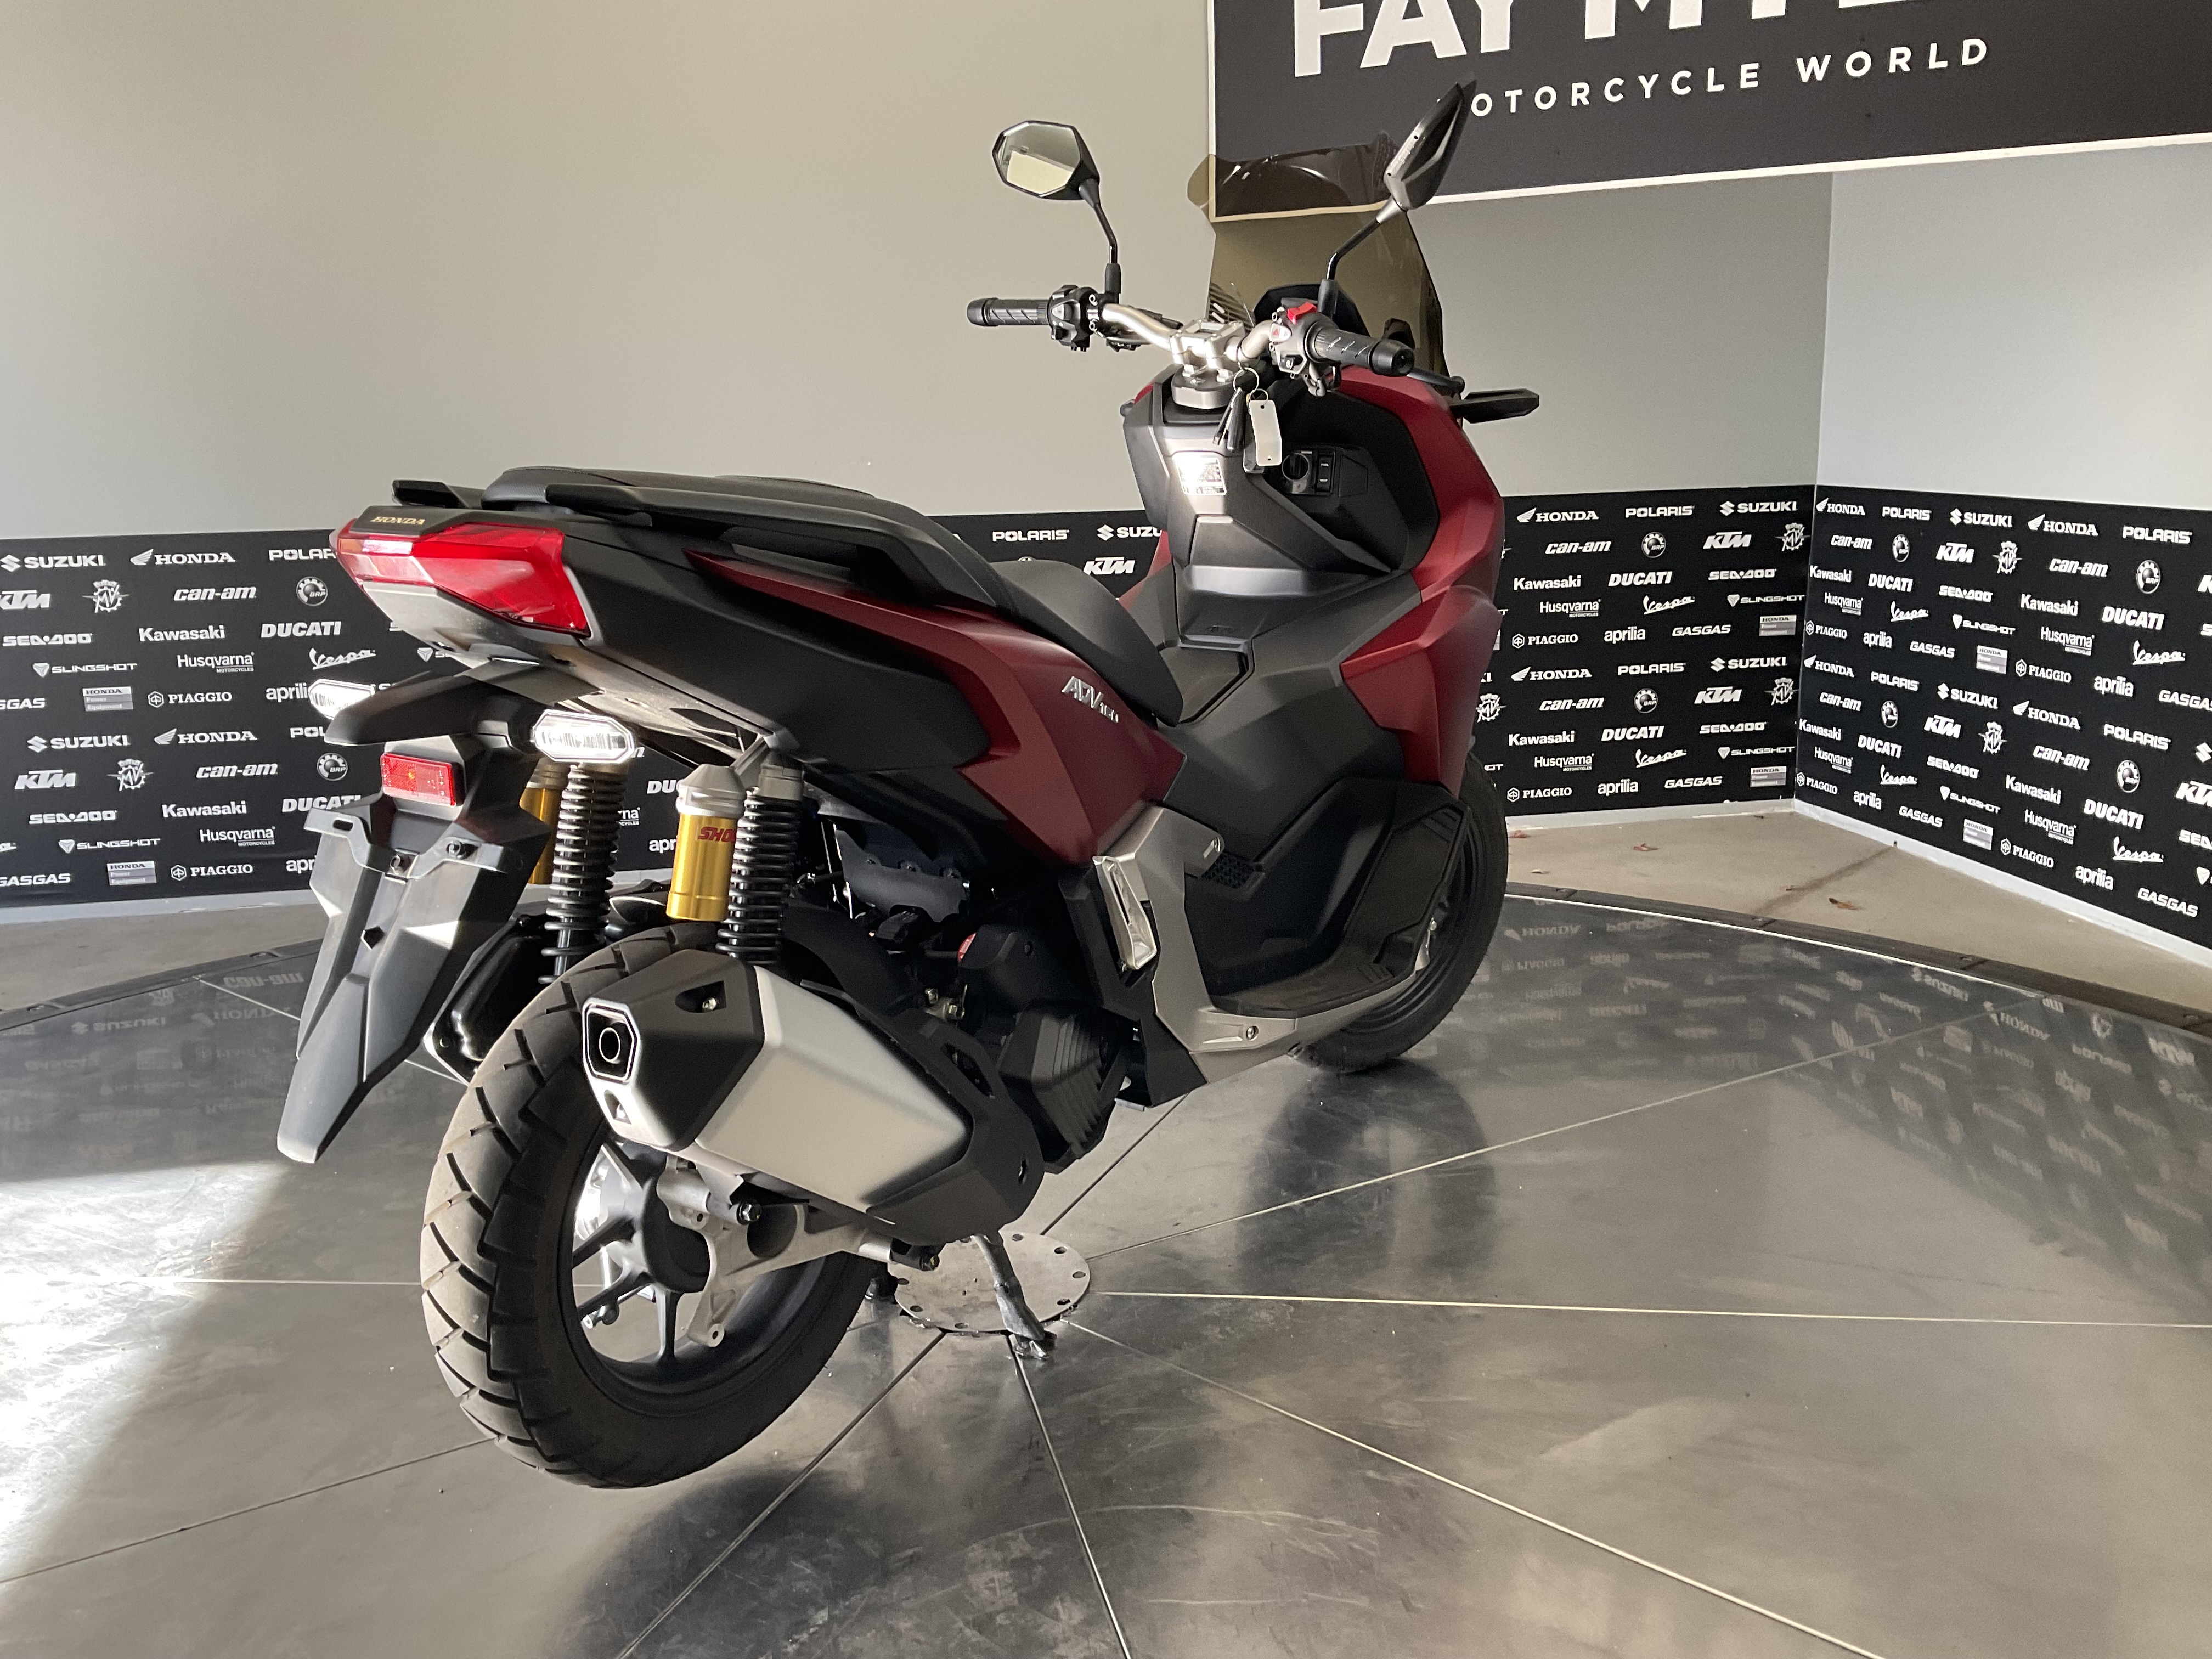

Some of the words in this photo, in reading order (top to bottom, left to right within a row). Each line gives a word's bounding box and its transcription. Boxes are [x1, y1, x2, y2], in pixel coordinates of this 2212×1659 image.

[1468, 63, 1761, 119] OTORCYCLE
[1796, 38, 1987, 82] WORLD
[1535, 510, 1599, 522] HONDA
[1625, 505, 1693, 518] POLARIS
[1737, 501, 1798, 514] SUZUKI
[1826, 503, 1866, 516] HONDA
[1882, 506, 1932, 521] POLARIS
[370, 516, 425, 525] HONDA
[1963, 512, 2013, 528] SUZUKI
[2042, 520, 2098, 537] HONDA
[992, 529, 1069, 542] POLARIS
[1116, 525, 1161, 539] SUZU
[1703, 531, 1752, 549] KTM
[2122, 526, 2192, 544] POLARIS
[1545, 540, 1611, 554] can-am
[1830, 534, 1873, 550] can-am
[154, 552, 236, 565] HONDA
[268, 548, 336, 561] POLAR
[1936, 542, 1975, 563] KTM
[24, 555, 105, 569] SUZUKI
[1083, 556, 1135, 575] KTM
[2049, 558, 2109, 577] can-am
[1513, 574, 1581, 590] Kawasaki
[1608, 571, 1673, 586] DUCATI
[1809, 565, 1852, 583] Kawasaki
[1867, 573, 1914, 592] DUCATI
[0, 590, 51, 610] KTM
[173, 586, 257, 601] can-am
[1740, 594, 1805, 603] SLINGSHOT
[1539, 601, 1599, 614] Husqvarna
[1643, 595, 1695, 615] Vespa
[1890, 601, 1929, 622] Vespa
[2021, 593, 2079, 616] Kawasaki
[2101, 606, 2165, 630] DUCATI
[138, 625, 225, 642] Kawasaki
[261, 620, 342, 638] DUCATI
[1604, 625, 1646, 644] aprilia
[1672, 624, 1731, 636] GASGAS
[1815, 625, 1847, 639] PIAGGIO
[1962, 619, 2016, 635] SLINGSHOT
[1527, 634, 1578, 645] PIAGGIO
[1863, 631, 1892, 648] aprilia
[2040, 625, 2092, 648] Husqvarna
[1910, 641, 1955, 658] GASGAS
[2132, 640, 2186, 665] Vespa
[177, 653, 253, 668] Husqvarna
[309, 647, 376, 670] Vespa
[1728, 656, 1787, 669] SUZUKI
[52, 663, 138, 674] SLINGSHOT
[1530, 668, 1593, 681] HONDA
[1617, 662, 1685, 676] POLARIS
[1814, 660, 1854, 678] HONDA
[2028, 665, 2072, 684] PIAGGIO
[1871, 671, 1920, 691] POLARIS
[2094, 675, 2134, 697] aprilia
[167, 691, 232, 704] PIAGGIO
[266, 682, 311, 703] aprili
[1694, 686, 1742, 704] KTM
[1950, 688, 1999, 709] SUZUKI
[0, 697, 46, 710] SGAS
[1539, 697, 1604, 711] can-am
[1819, 692, 1862, 712] can-am
[1923, 715, 1961, 739] KTM
[2027, 707, 2081, 730] HONDA
[177, 731, 258, 744] HONDA
[1508, 730, 1575, 746] Kawasaki
[1601, 725, 1664, 741] DUCATI
[1799, 718, 1842, 741] Kawasaki
[2103, 724, 2171, 751] POLARIS
[50, 735, 130, 749] SUZUKI
[1857, 735, 1903, 758] DUCATI
[1635, 749, 1687, 769] Vespa
[1731, 746, 1795, 756] SLINGSHOT
[2033, 745, 2090, 771] can-am
[1534, 755, 1593, 768] Husqvarna
[196, 763, 278, 778] can-am
[1880, 764, 1917, 786] Vespa
[14, 769, 76, 790] KTM
[1597, 778, 1639, 797] aprilia
[1664, 776, 1723, 789] GASGAS
[1806, 777, 1838, 794] PIAGGIO
[1522, 787, 1572, 799] PIAGGIO
[2005, 775, 2062, 805] Kawasaki
[162, 800, 247, 818] Kawasaki
[1853, 791, 1882, 810] aprilia
[1950, 792, 2001, 814] SLINGSHOT
[1899, 805, 1943, 828] GASGAS
[2083, 798, 2144, 830] DUCATI
[2024, 809, 2074, 837] Husqvarna
[199, 828, 273, 842] Husqvarna
[698, 826, 736, 843] SHO
[76, 838, 161, 850] SLINGSHOT
[2112, 836, 2164, 863] Vespa
[2012, 845, 2054, 868] PIAGGIO
[190, 864, 253, 877] PIAGGIO
[2075, 865, 2114, 890] aprilia
[2137, 887, 2198, 917] GASGAS
